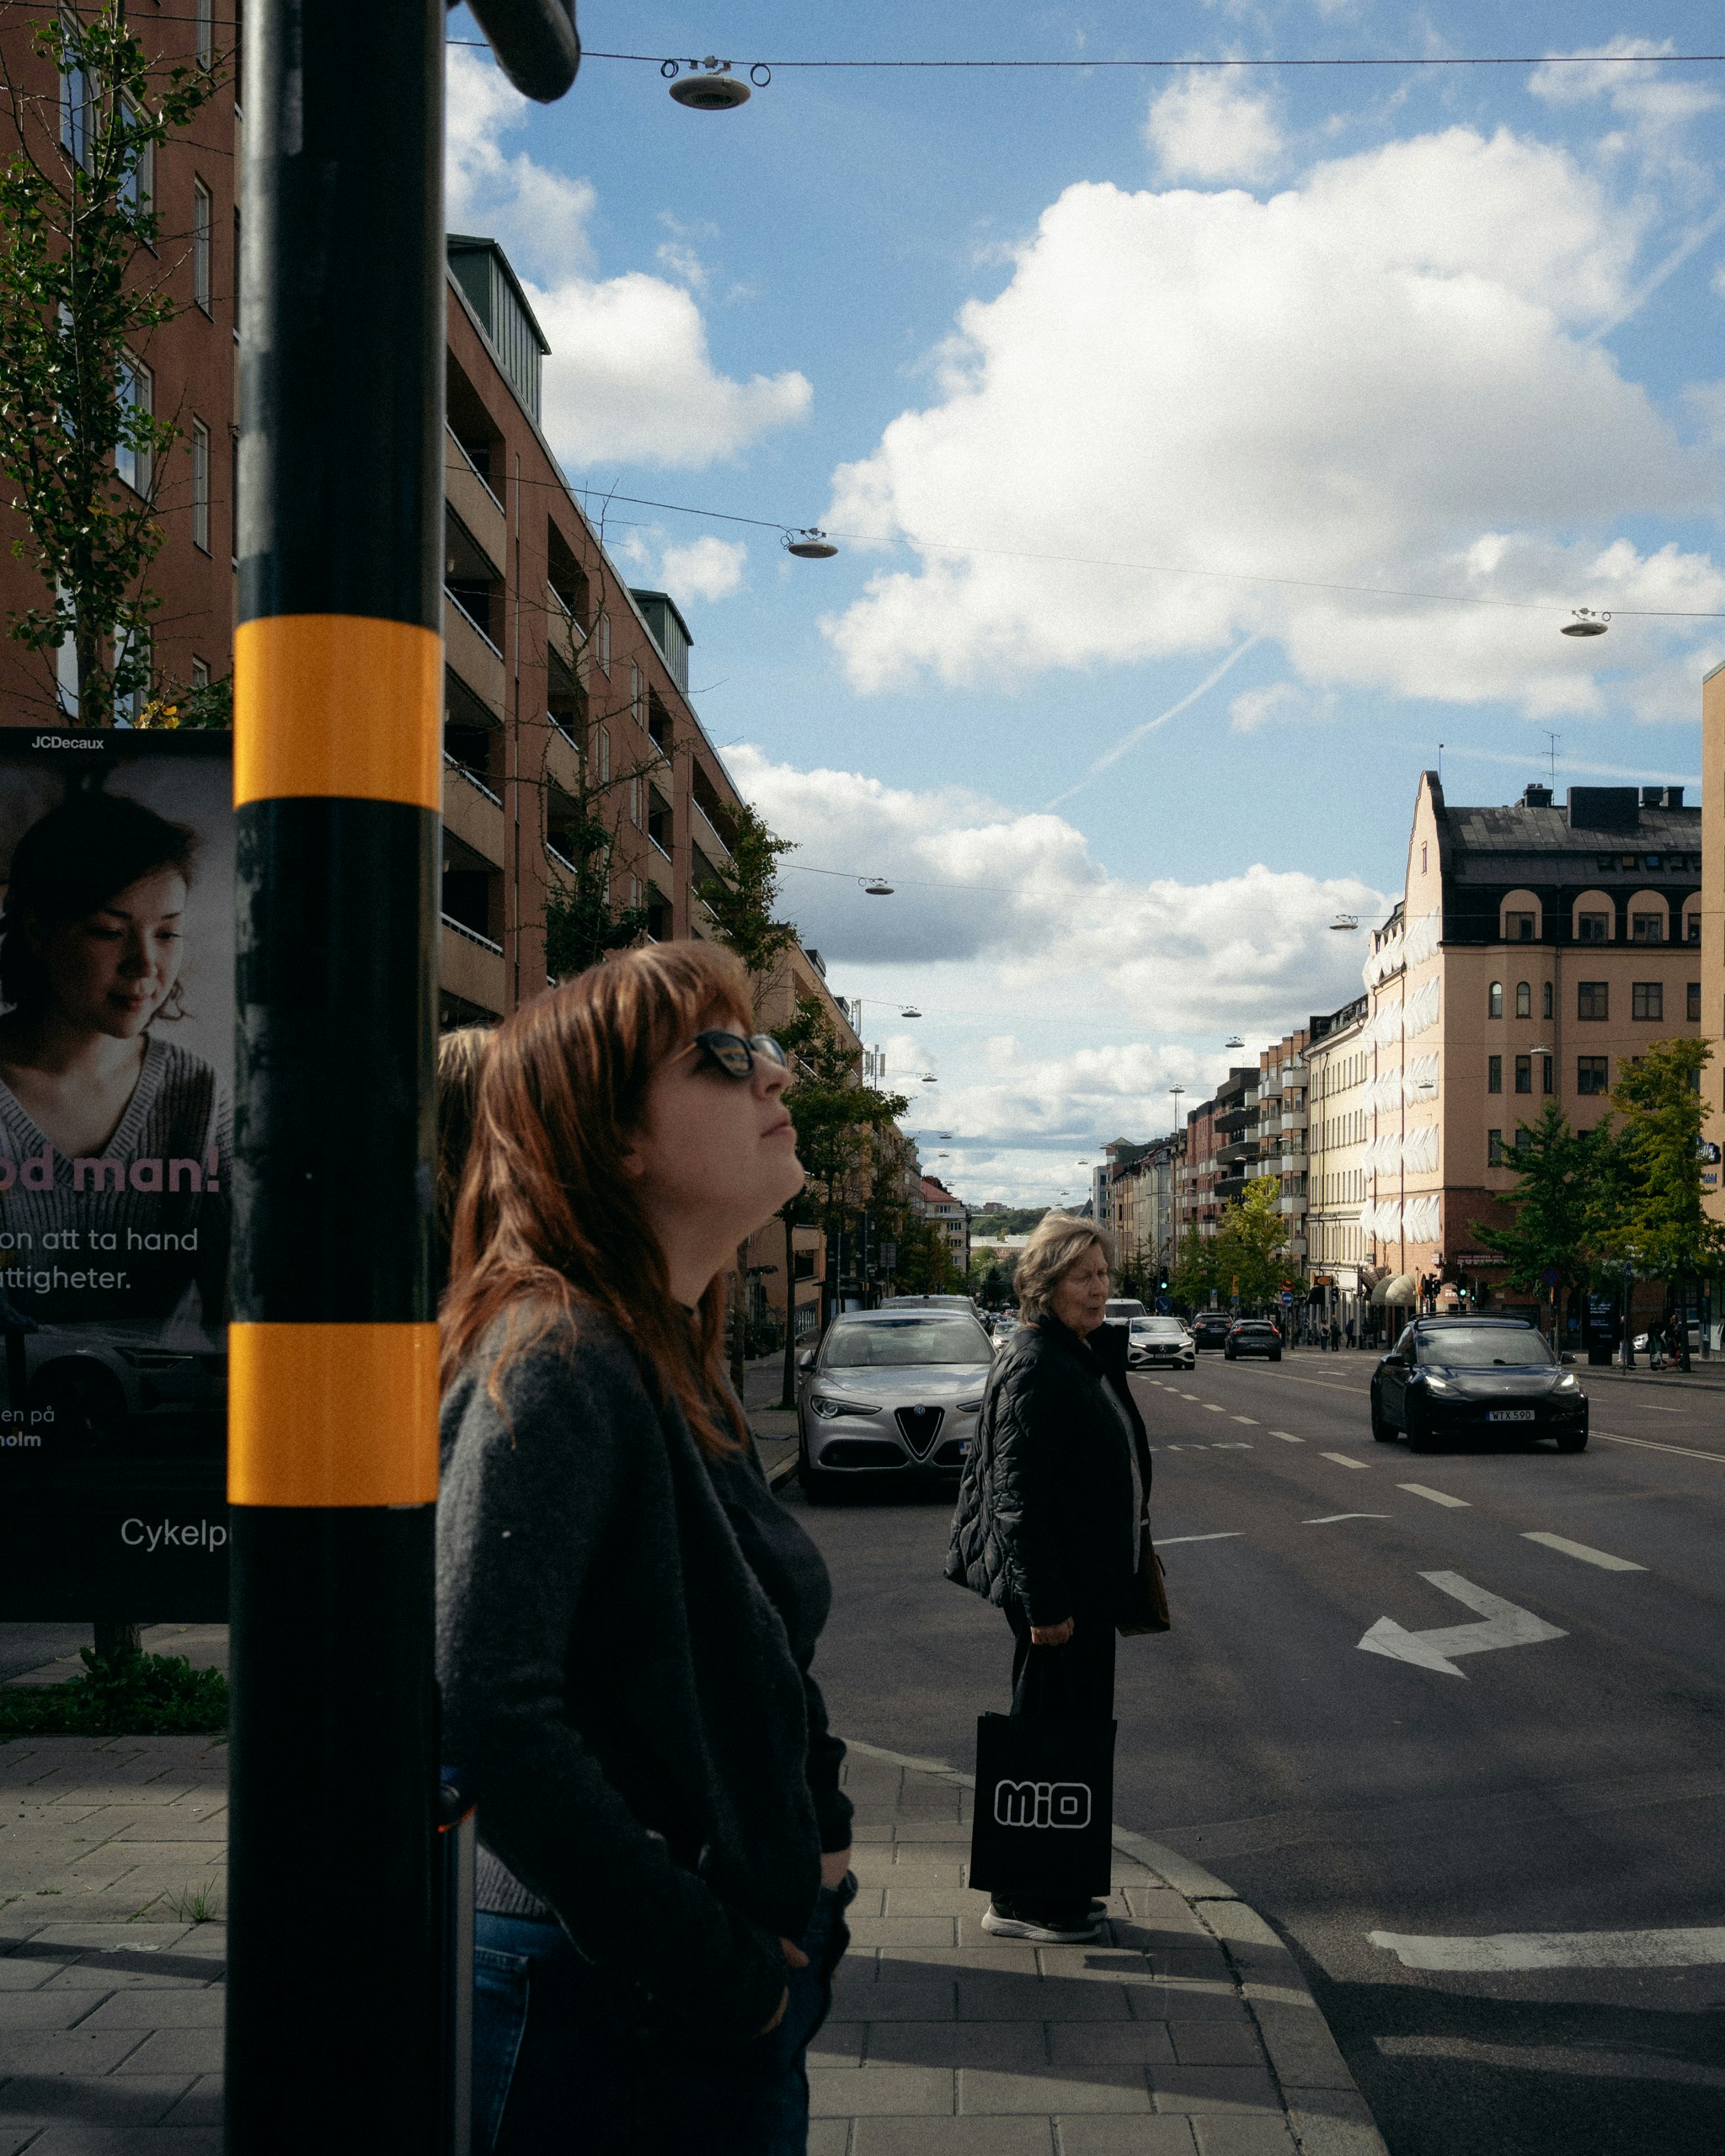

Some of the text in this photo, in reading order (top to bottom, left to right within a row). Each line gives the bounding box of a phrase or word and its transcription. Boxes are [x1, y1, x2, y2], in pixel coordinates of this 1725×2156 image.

[31, 735, 104, 750] JCDecaux
[73, 1145, 220, 1193] man!
[0, 1227, 198, 1251] on att ta hand
[0, 1265, 131, 1294] ttigheter.
[1, 1406, 55, 1425] en på
[1493, 1411, 1531, 1420] WTX 59D
[120, 1518, 232, 1552] Cykelp
